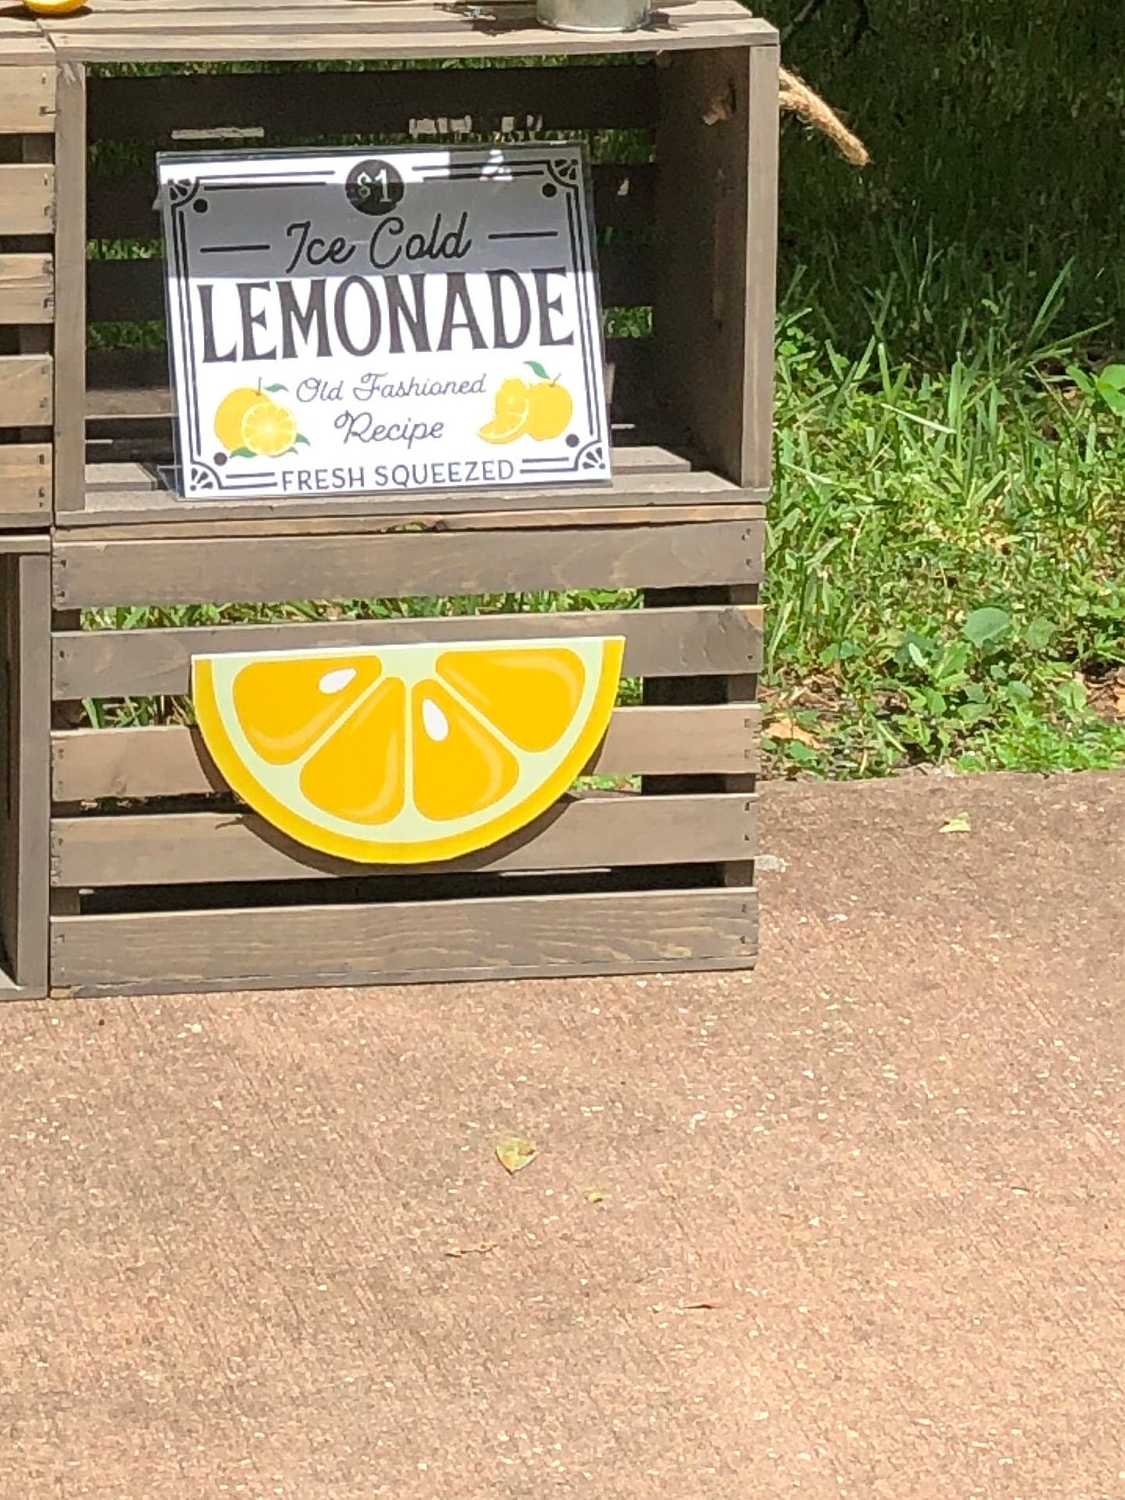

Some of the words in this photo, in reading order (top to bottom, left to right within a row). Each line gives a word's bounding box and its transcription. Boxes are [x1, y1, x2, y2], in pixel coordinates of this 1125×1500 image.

[356, 167, 393, 203] $1
[285, 220, 357, 274] Ice
[369, 211, 473, 269] Cold
[197, 266, 575, 364] LEMONADE
[296, 377, 343, 404] Old
[352, 372, 488, 402] Fashioned
[333, 411, 445, 449] Recipe
[281, 467, 365, 492] FRESH
[374, 459, 515, 489] SQUEEZED
